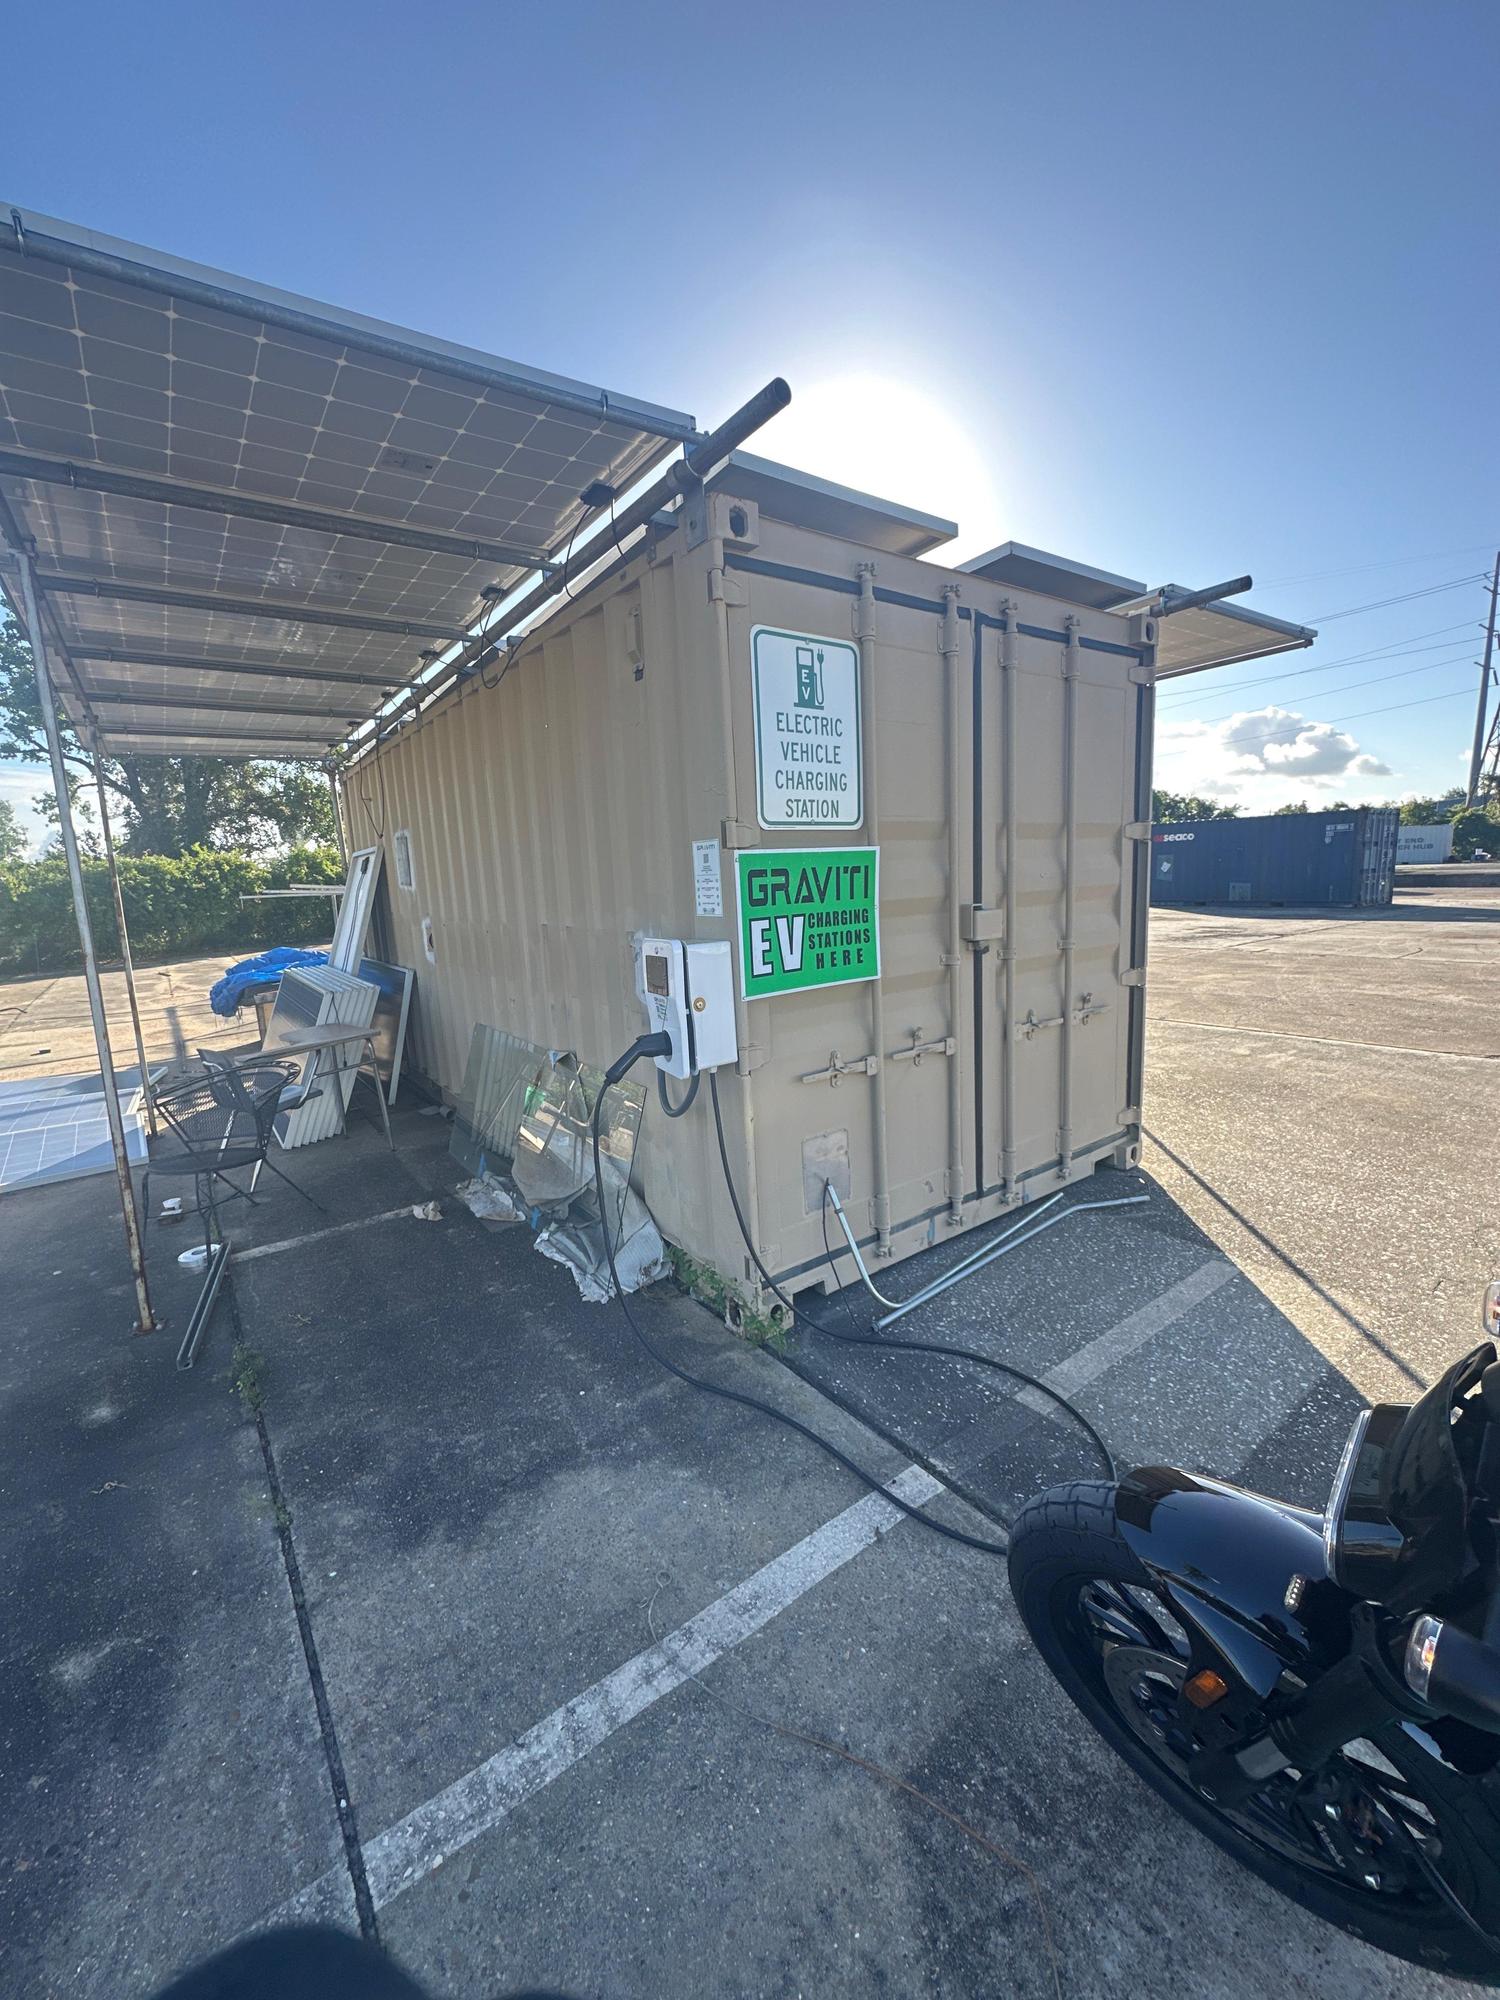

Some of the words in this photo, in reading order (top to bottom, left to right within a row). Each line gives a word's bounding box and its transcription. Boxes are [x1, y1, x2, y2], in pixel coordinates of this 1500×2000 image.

[801, 669, 811, 700] EV
[776, 711, 843, 737] ELECTRIC
[780, 741, 841, 765] VEHICLE
[775, 769, 848, 792] CHARGING
[785, 798, 839, 819] STATION
[1163, 832, 1195, 842] seaco
[747, 864, 870, 907] GRAVITI
[808, 908, 869, 929] CHARGING
[749, 913, 806, 978] EV
[808, 928, 870, 950] STATIONS
[816, 948, 864, 970] HERE
